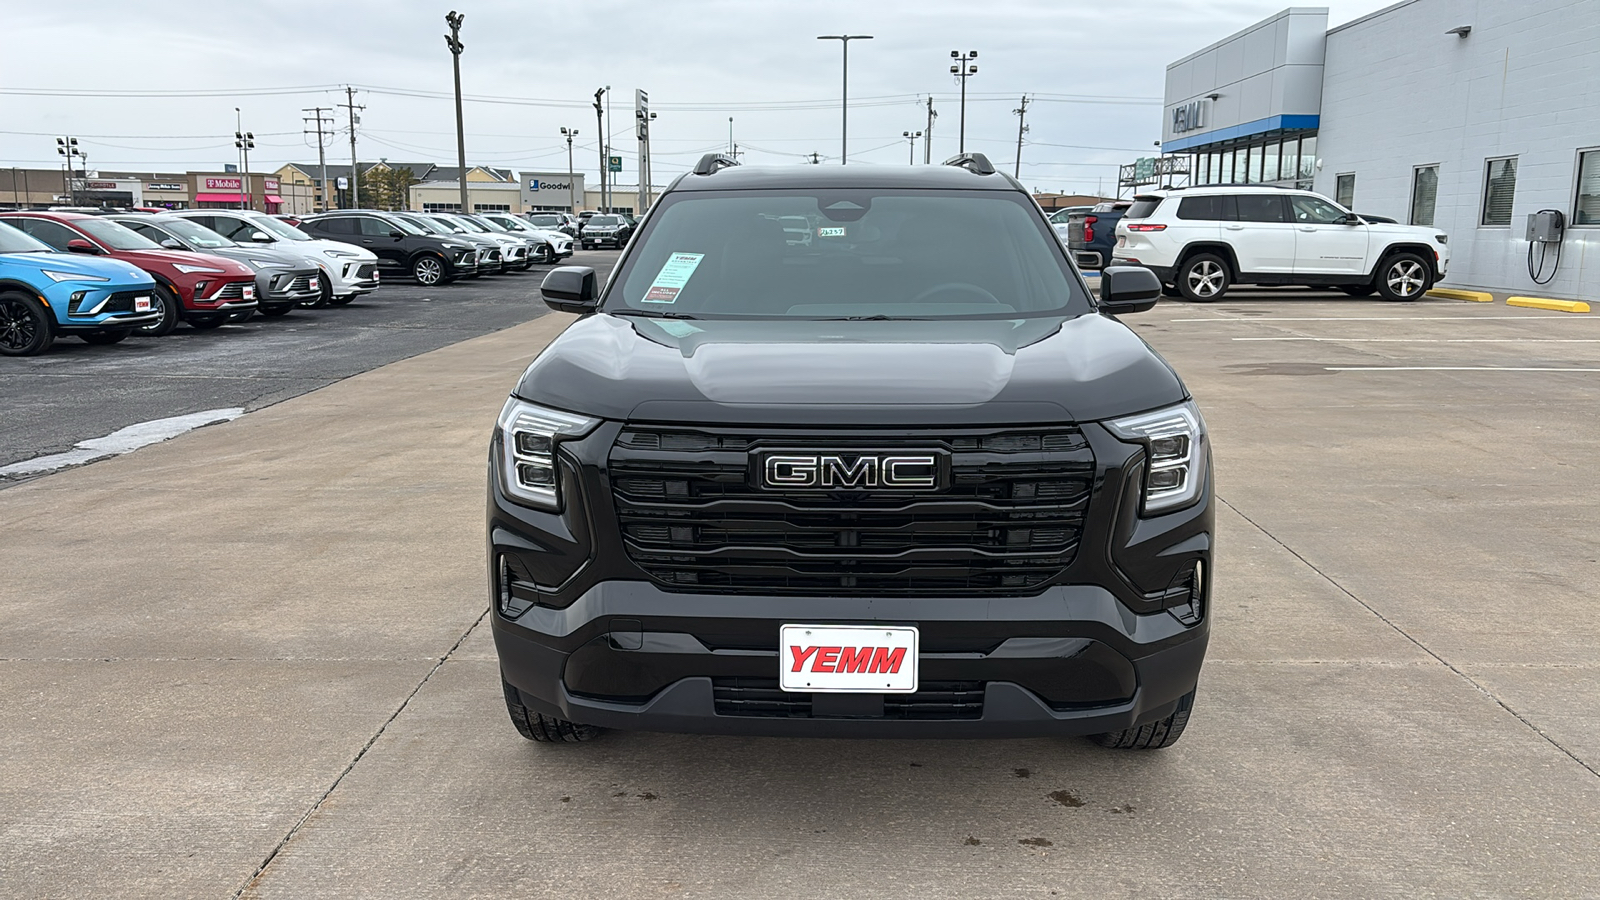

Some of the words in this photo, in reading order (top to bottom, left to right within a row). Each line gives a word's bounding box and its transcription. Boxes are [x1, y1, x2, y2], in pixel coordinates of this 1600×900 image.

[215, 179, 240, 189] Mobile
[539, 182, 575, 190] Goodwil
[765, 456, 935, 486] GMC
[790, 645, 908, 674] YEMM
